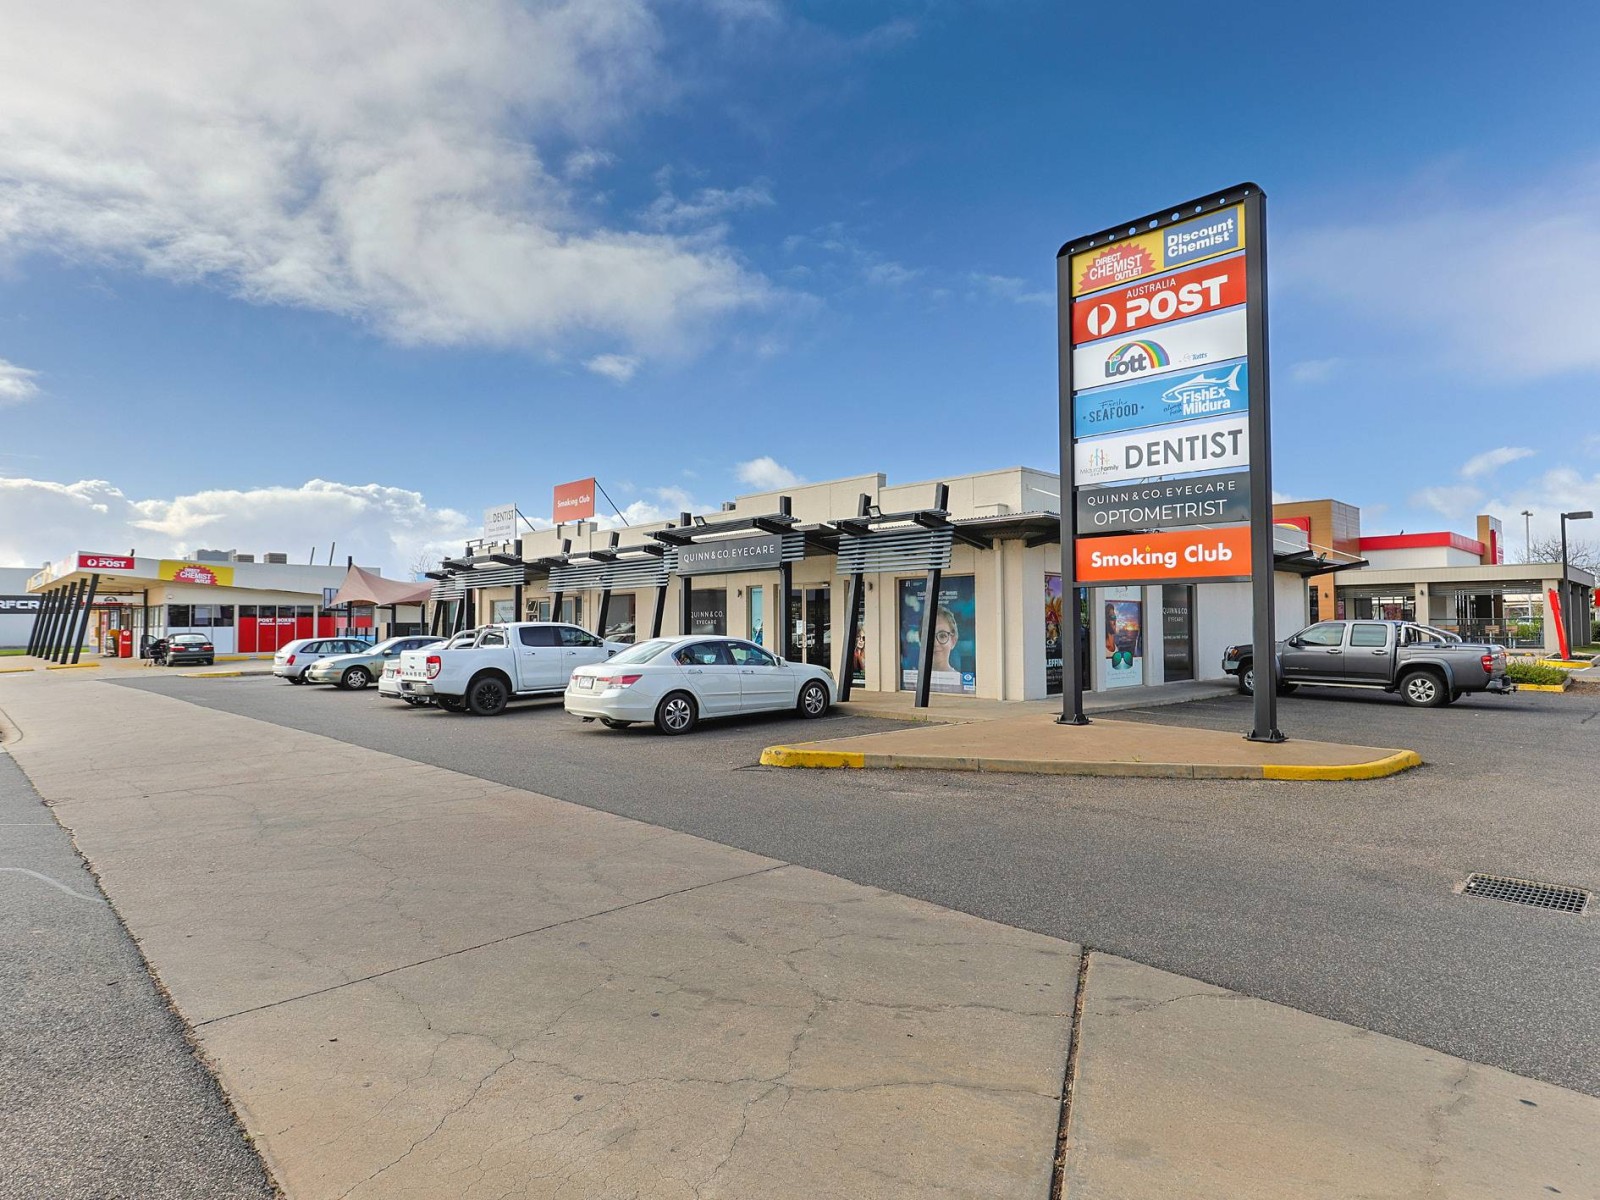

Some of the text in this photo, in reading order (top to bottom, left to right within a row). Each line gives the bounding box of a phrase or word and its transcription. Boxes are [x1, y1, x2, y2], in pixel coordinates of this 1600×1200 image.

[1168, 218, 1233, 247] Discount
[1089, 254, 1142, 280] CHEMIST
[1095, 252, 1121, 267] DIRECT
[1114, 267, 1142, 281] OUTLET
[1126, 278, 1176, 298] AUSTRALIA
[1126, 275, 1228, 327] POST
[1105, 353, 1147, 378] Lott
[1182, 386, 1226, 404] FishEx
[1089, 404, 1138, 422] SEAFOOD
[1183, 398, 1230, 415] Mildura
[1125, 429, 1243, 469] DENTIST
[557, 494, 590, 508] Smoking Club
[1087, 481, 1236, 506] QUINN & CO. EYECARE
[493, 510, 514, 523] DENTIST
[1094, 500, 1227, 526] OPTOMETRIST
[684, 545, 775, 563] QUINN & CO. EYECARE
[1091, 543, 1232, 568] Smoking Club
